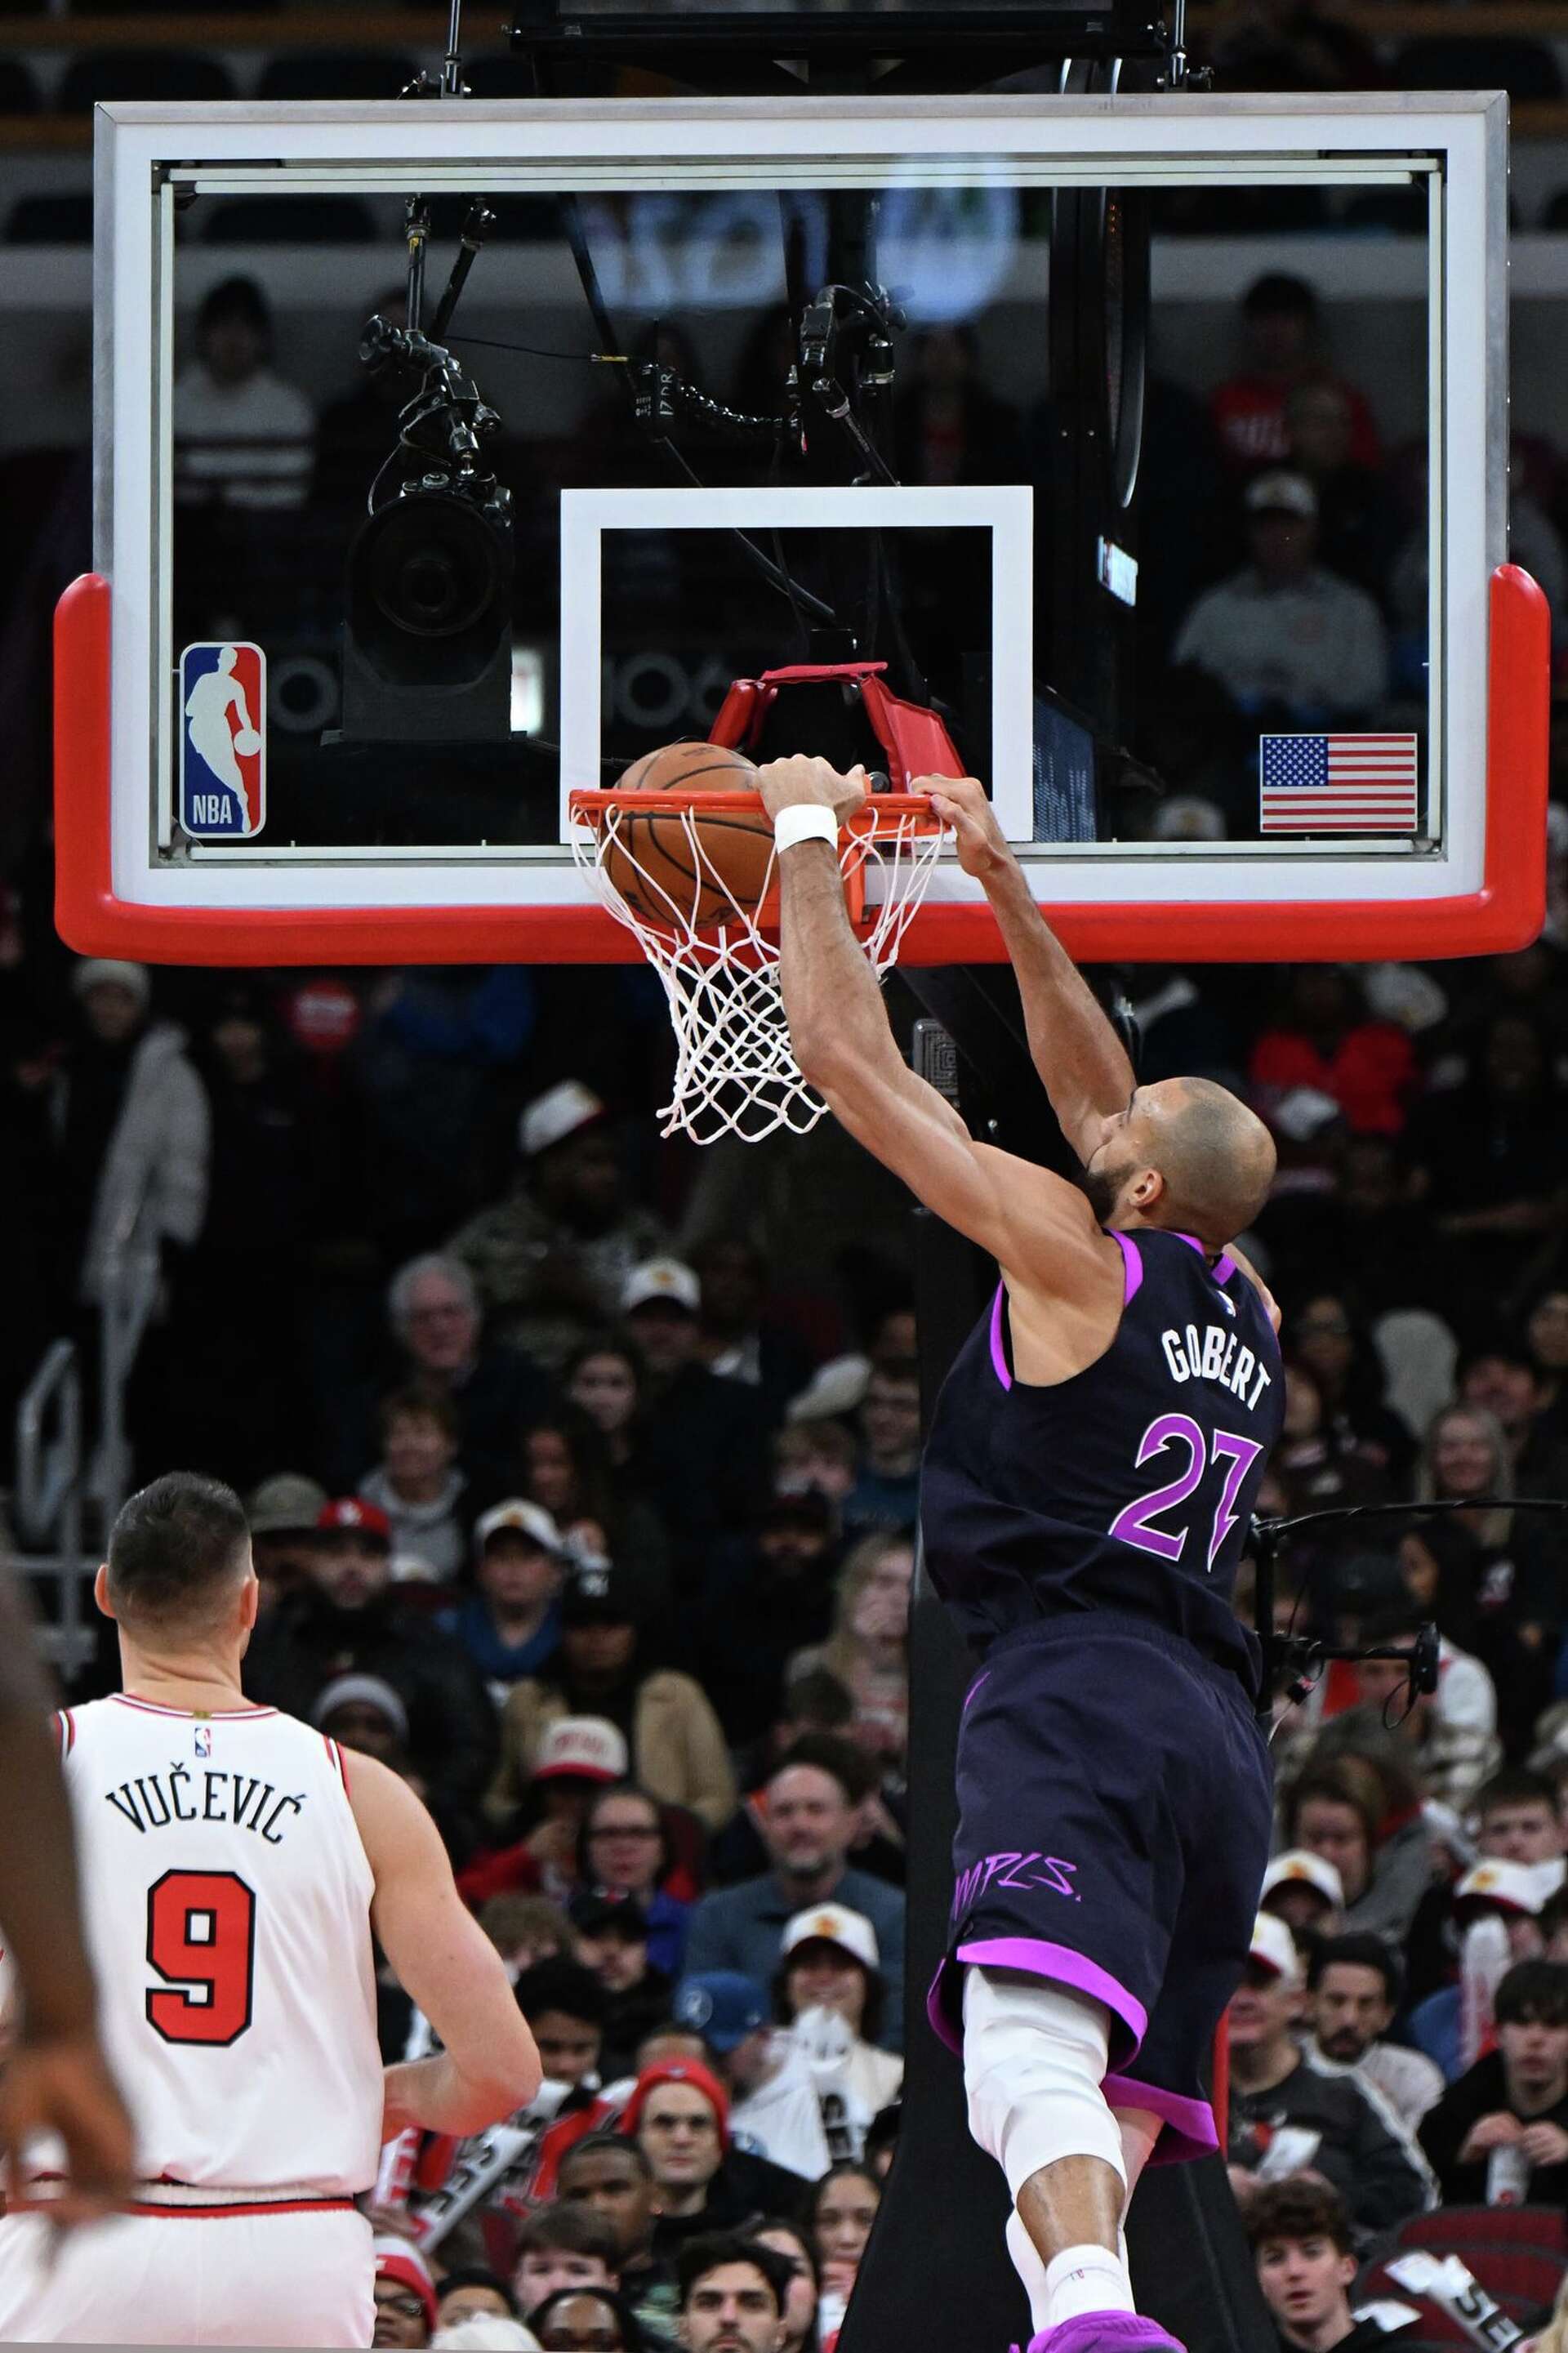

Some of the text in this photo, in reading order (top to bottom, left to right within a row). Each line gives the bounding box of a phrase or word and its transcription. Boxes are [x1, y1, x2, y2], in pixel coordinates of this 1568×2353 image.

[193, 795, 233, 825] NBA
[1161, 1324, 1272, 1411] GOBERT
[1107, 1412, 1265, 1573] 27
[105, 1762, 308, 1845] VUČEVIĆ
[145, 1868, 256, 2048] 9
